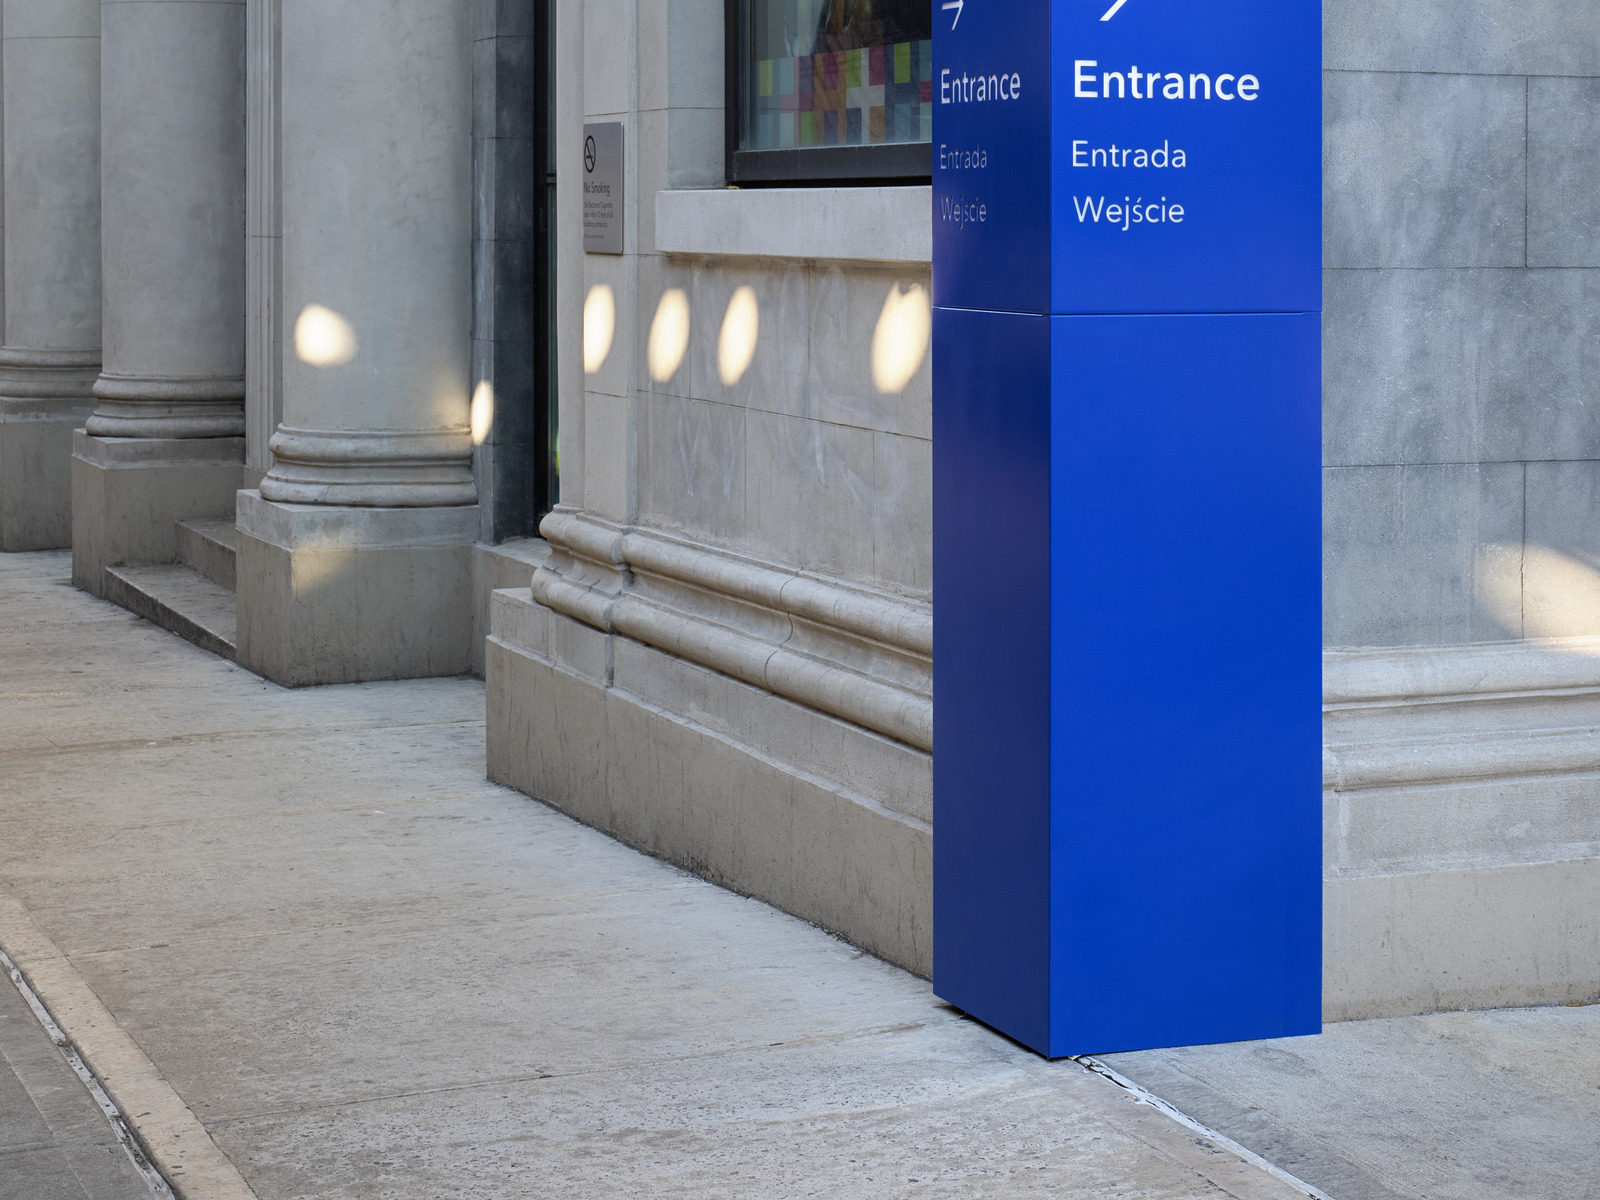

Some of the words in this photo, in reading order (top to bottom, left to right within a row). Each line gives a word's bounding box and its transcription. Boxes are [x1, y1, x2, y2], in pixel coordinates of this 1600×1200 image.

[940, 68, 1021, 104] Entrance
[1073, 59, 1260, 101] Entrance
[940, 141, 987, 170] Entrada
[1072, 139, 1187, 169] Entrada
[584, 181, 591, 194] No
[591, 180, 610, 197] Smoking
[940, 195, 987, 230] Wejście
[1073, 195, 1185, 232] Wejście
